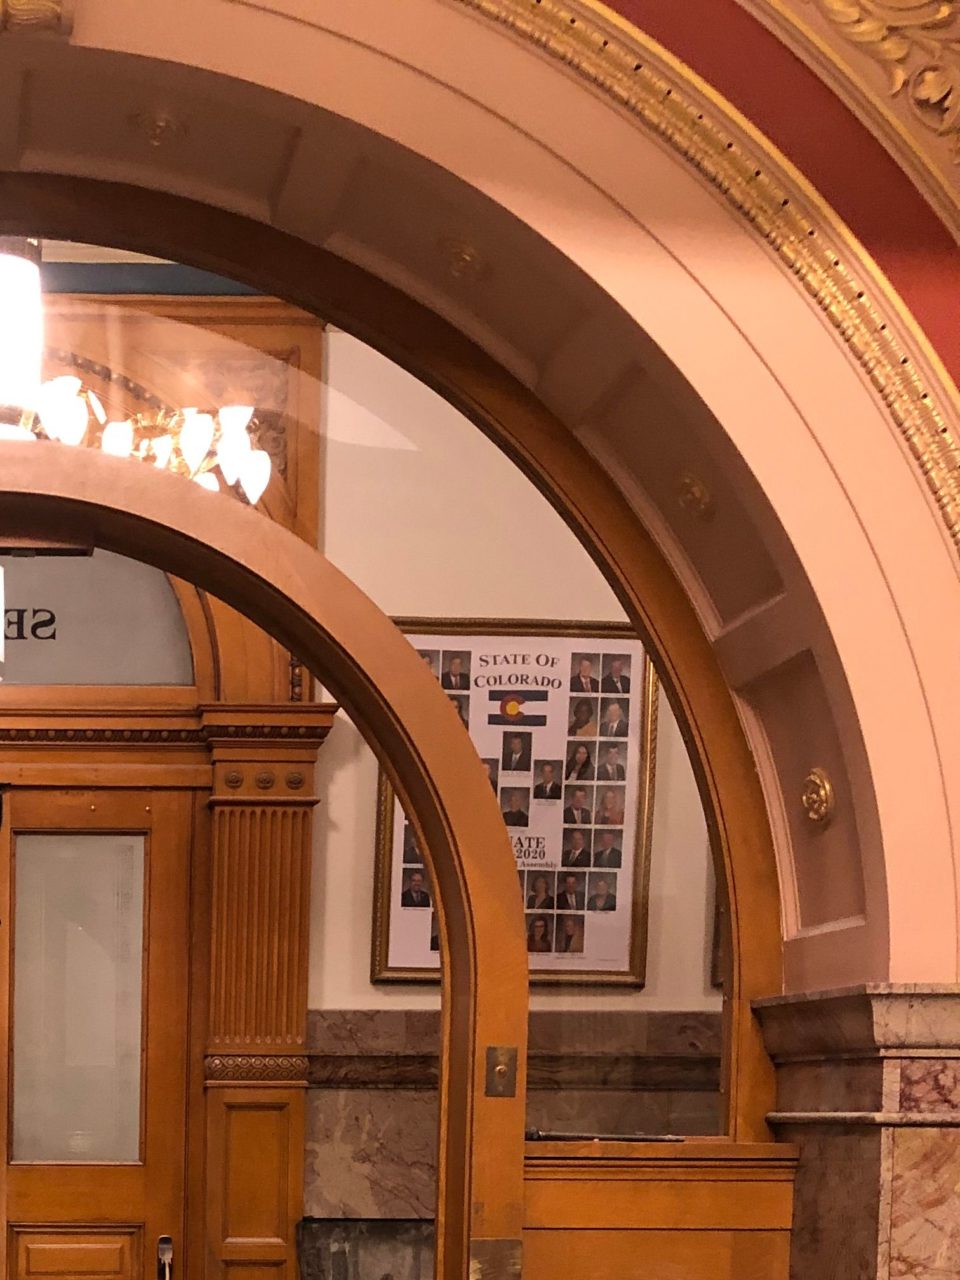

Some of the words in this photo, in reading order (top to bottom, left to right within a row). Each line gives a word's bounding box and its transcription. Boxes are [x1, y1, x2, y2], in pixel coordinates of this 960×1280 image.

[479, 653, 531, 667] STATE
[535, 653, 560, 668] OF
[473, 673, 562, 690] COLORADO
[510, 835, 546, 849] ATE
